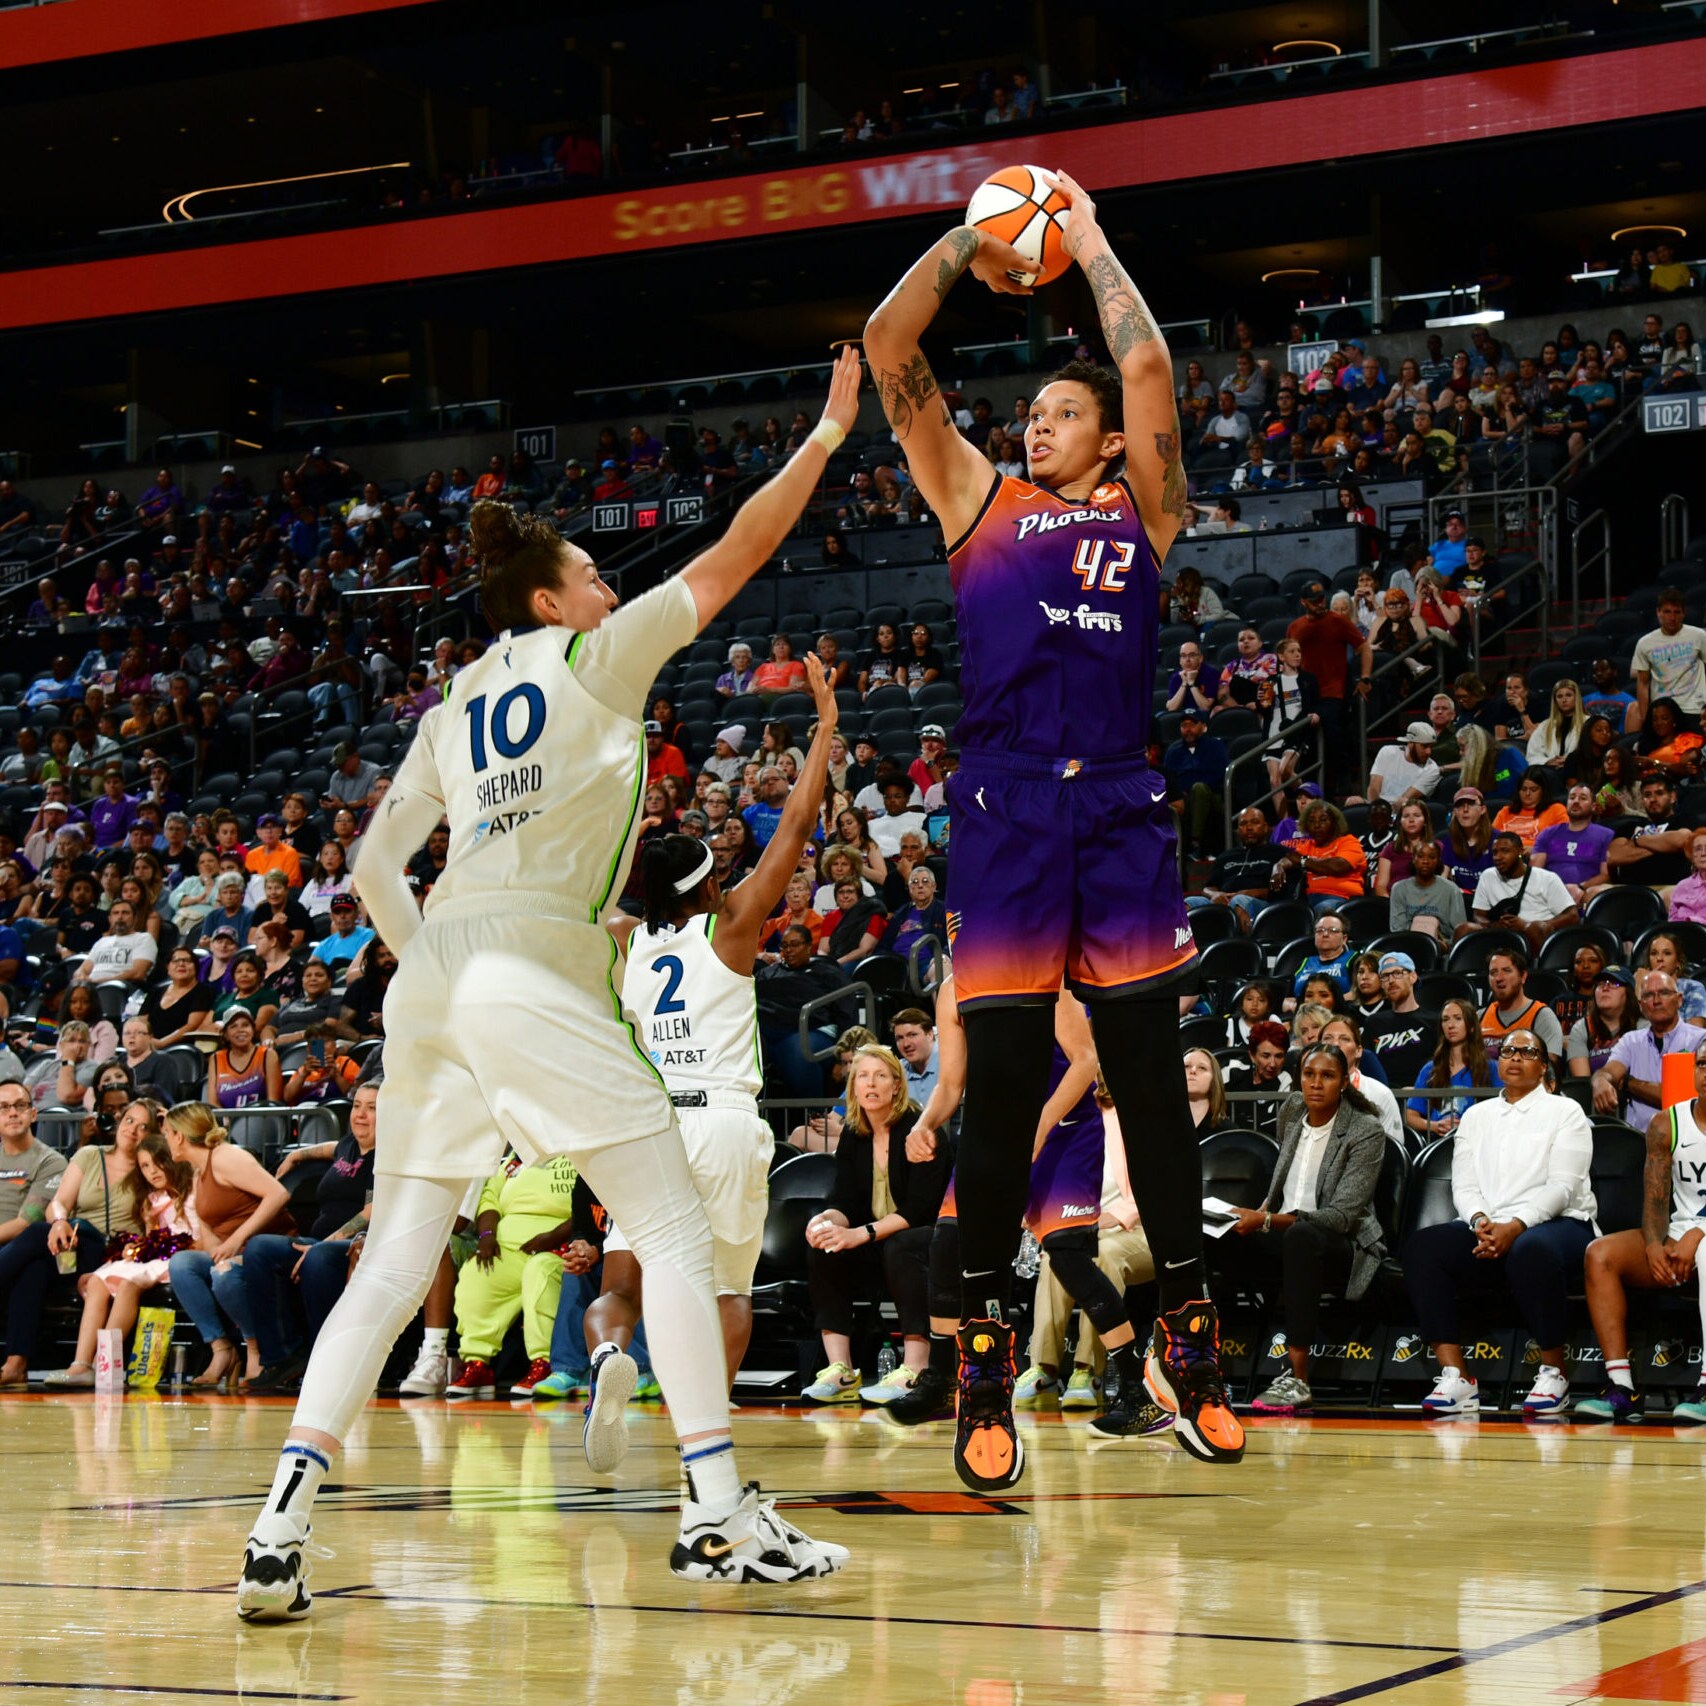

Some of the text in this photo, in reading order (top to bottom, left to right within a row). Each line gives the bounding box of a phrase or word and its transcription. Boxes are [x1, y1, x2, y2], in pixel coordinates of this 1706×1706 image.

[614, 194, 746, 240] Score
[761, 172, 849, 222] BIG
[1653, 405, 1684, 427] 102
[522, 434, 548, 457] 101
[600, 509, 621, 528] 101
[638, 510, 657, 528] EXIT
[1015, 508, 1124, 542] Phoenix
[1072, 538, 1136, 592] 42
[1072, 603, 1123, 632] fry's
[465, 682, 547, 773] 10
[477, 764, 542, 812] SHEPARD
[489, 810, 543, 836] AT&
[651, 954, 686, 1016] 2
[652, 1017, 691, 1043] ALLEN
[1375, 1027, 1424, 1054] PHX
[664, 1049, 707, 1066] AT&T
